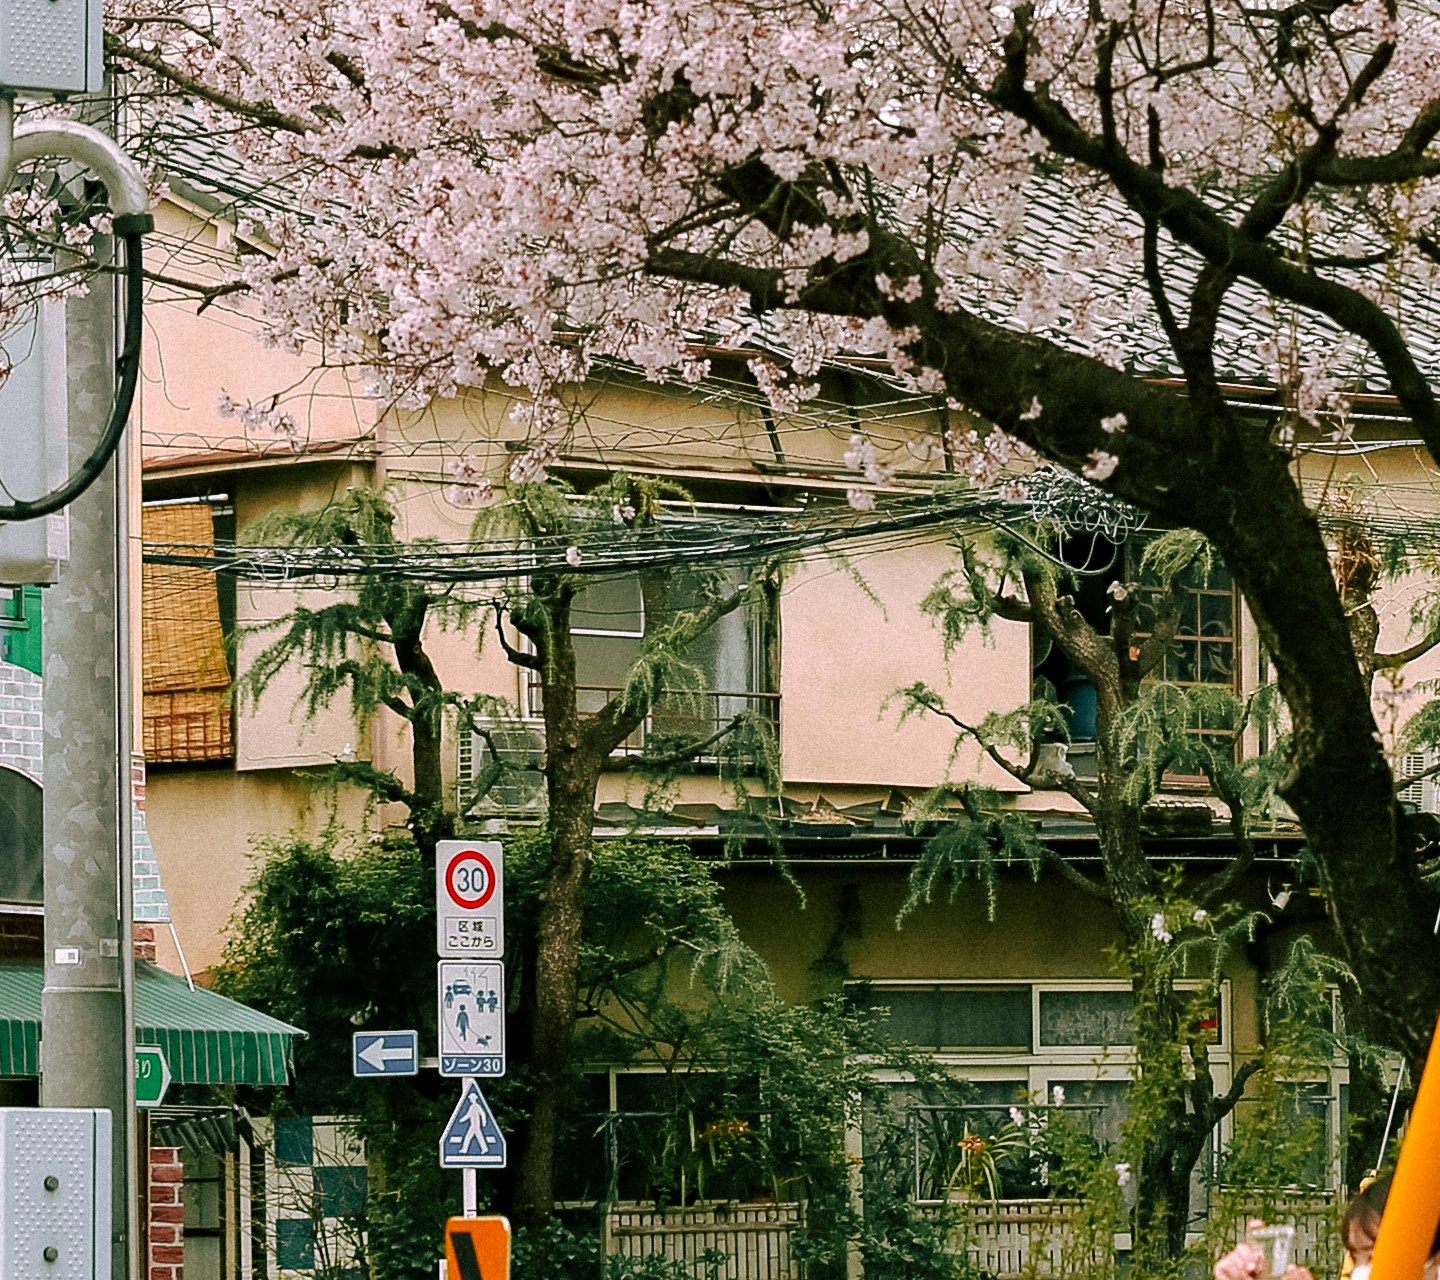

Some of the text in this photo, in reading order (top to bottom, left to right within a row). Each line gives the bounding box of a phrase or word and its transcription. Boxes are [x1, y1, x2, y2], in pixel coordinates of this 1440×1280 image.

[457, 867, 484, 893] 30
[458, 921, 483, 934] 区域
[448, 935, 494, 949] ここから
[135, 1058, 152, 1079] り
